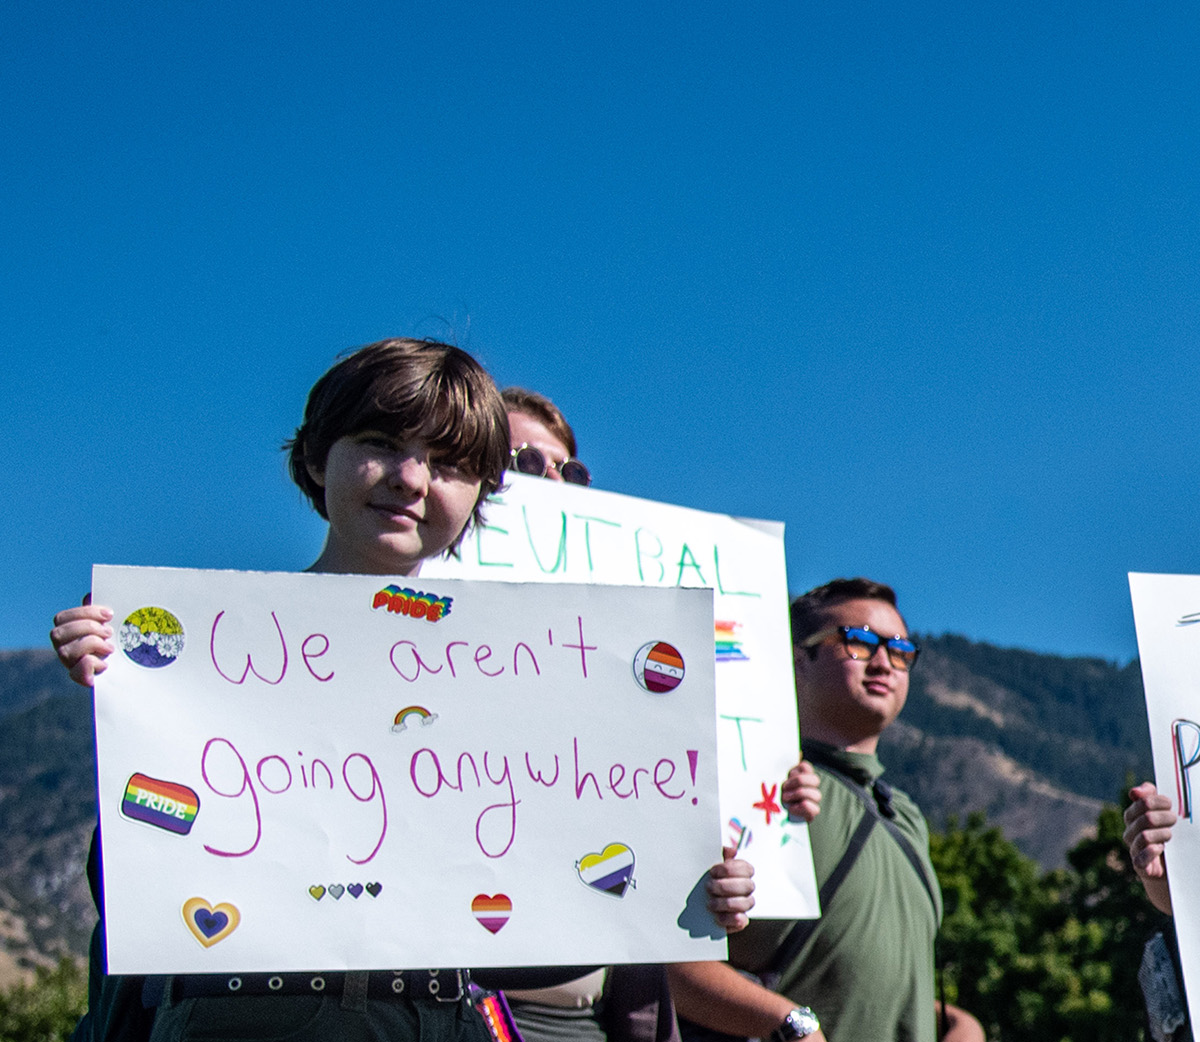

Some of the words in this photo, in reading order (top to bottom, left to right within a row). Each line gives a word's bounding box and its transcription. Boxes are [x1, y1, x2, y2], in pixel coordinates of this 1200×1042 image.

[454, 494, 762, 599] EUTRAL
[373, 586, 451, 622] PRIDE
[210, 610, 335, 685] We
[389, 616, 598, 682] aren't
[135, 787, 188, 820] PRIDE
[201, 737, 388, 865] going
[409, 737, 700, 859] anywhere!
